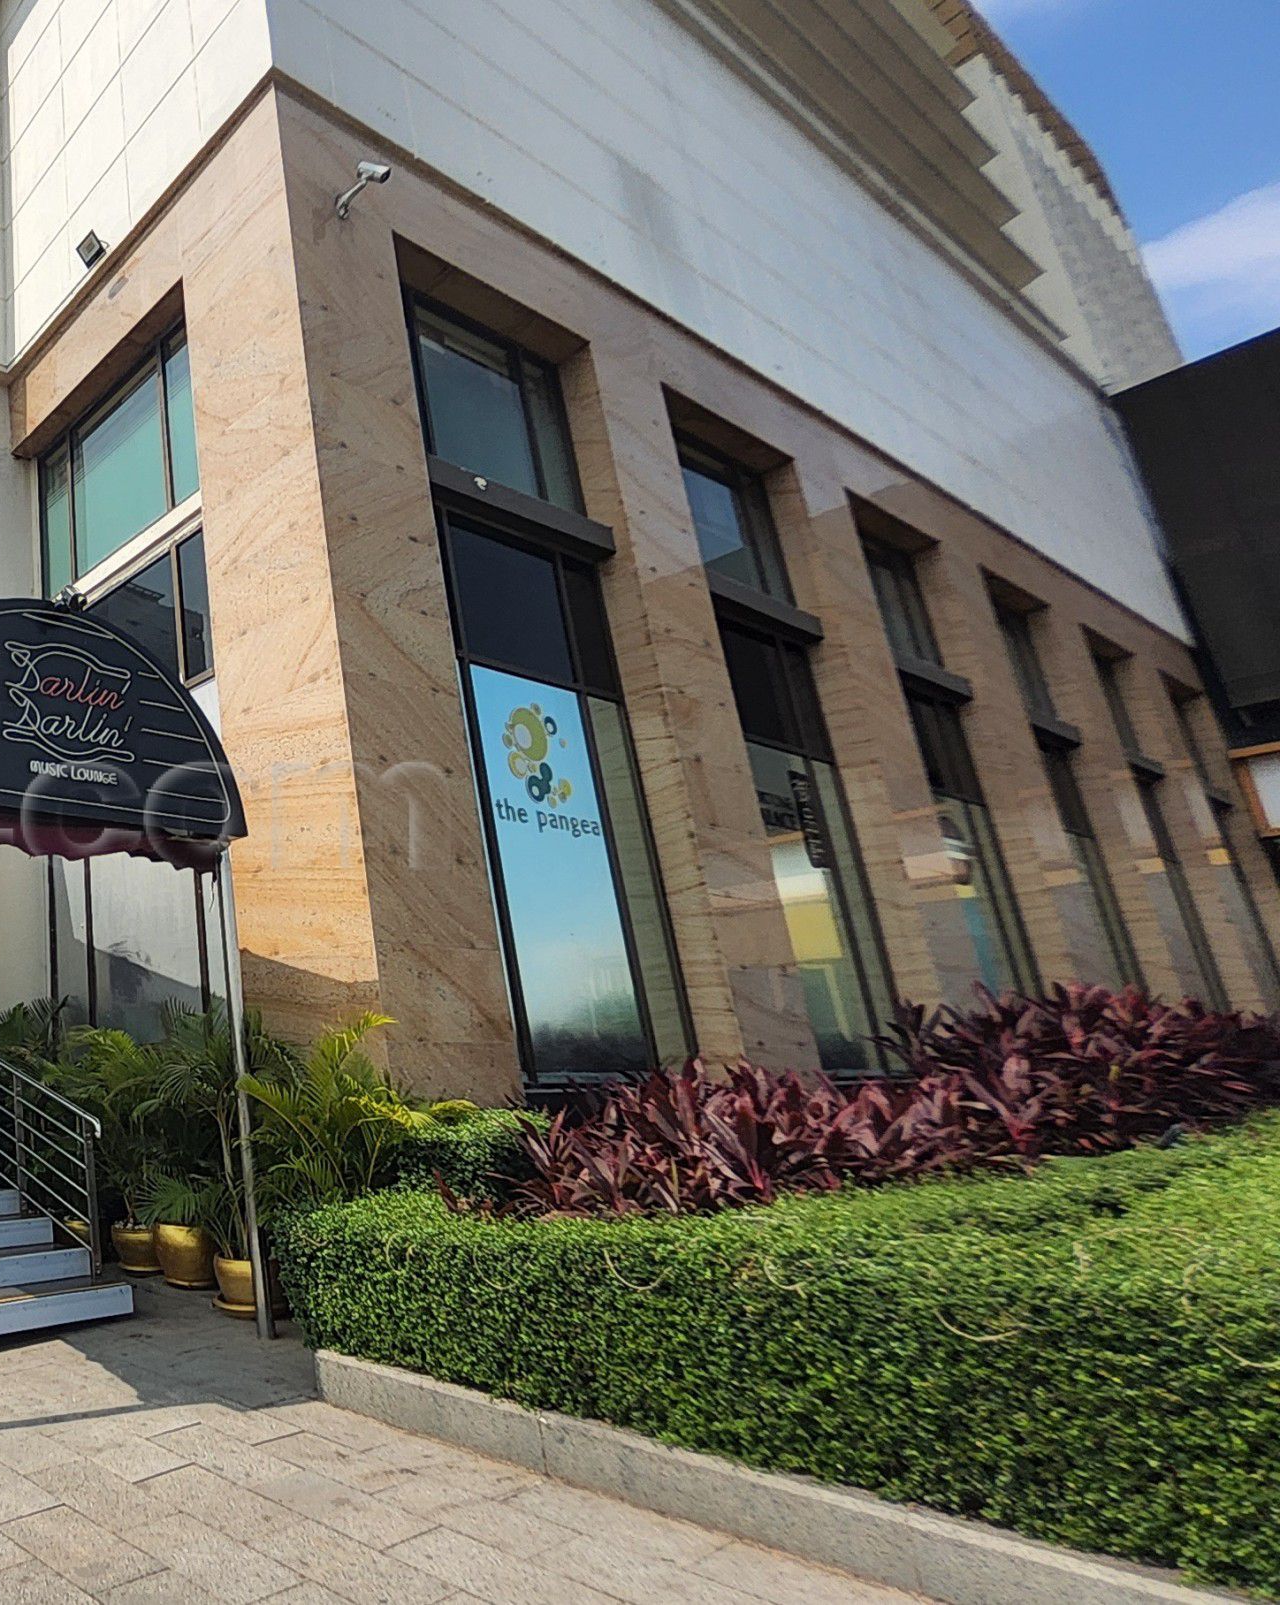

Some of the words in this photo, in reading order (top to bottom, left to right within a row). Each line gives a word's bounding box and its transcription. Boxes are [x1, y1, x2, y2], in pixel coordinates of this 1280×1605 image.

[5, 649, 132, 709] Darlin'
[3, 688, 133, 747] Darlin'
[30, 760, 69, 778] MUSIC
[70, 765, 118, 785] LOUNGE
[495, 798, 529, 824] the
[535, 810, 601, 838] pangea
